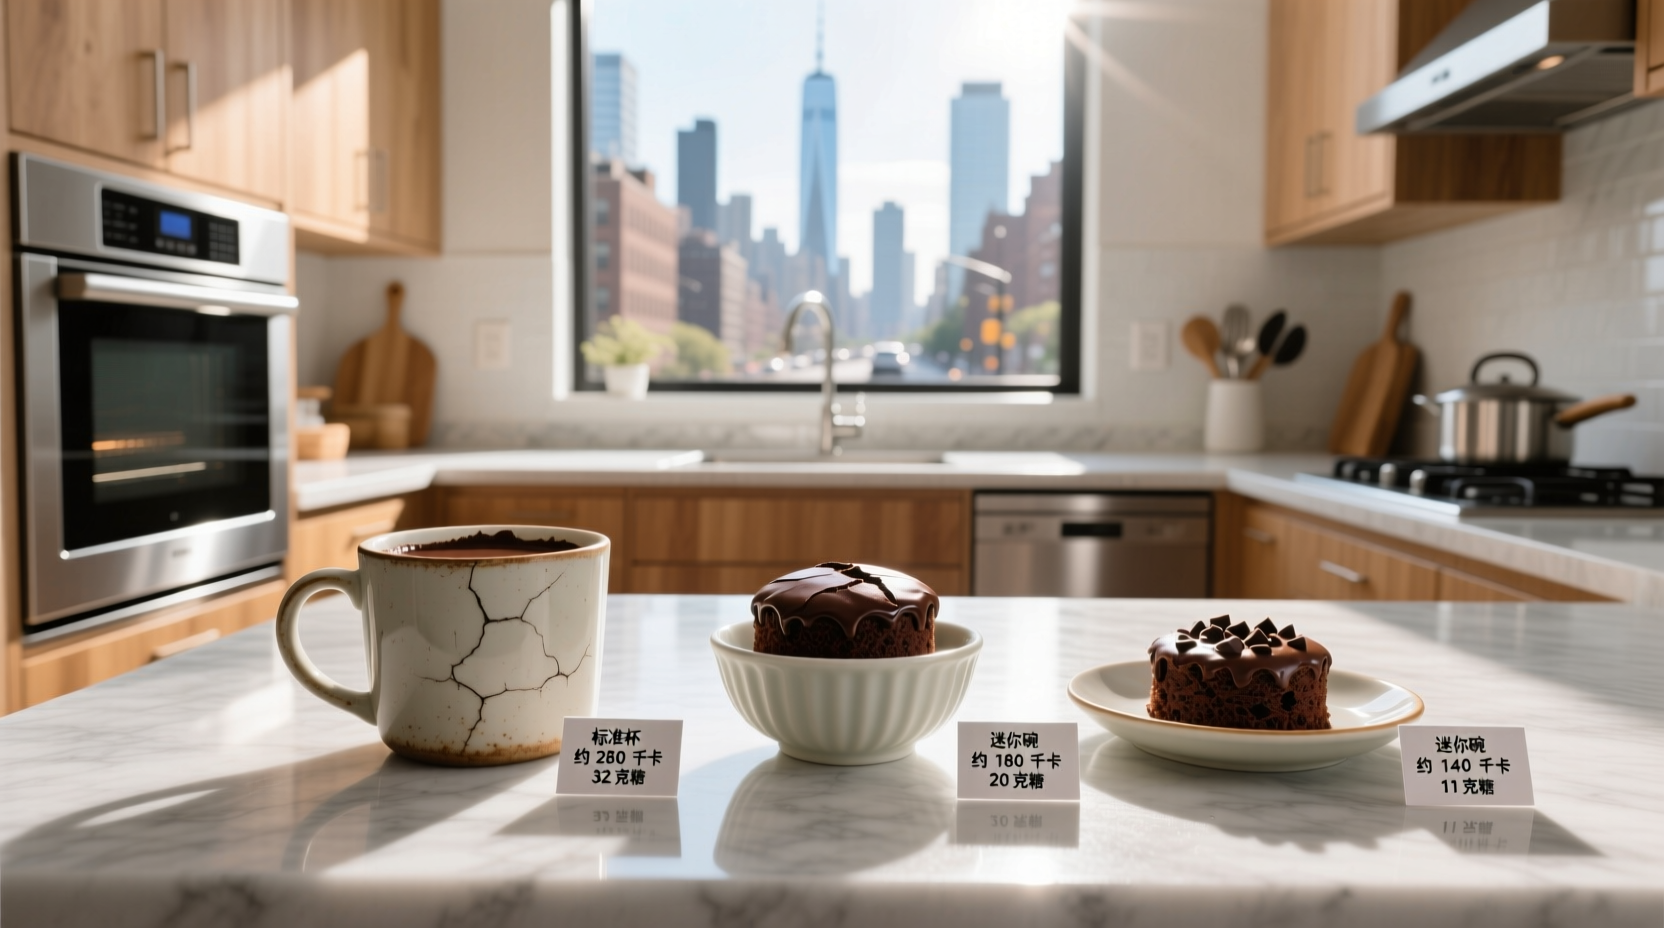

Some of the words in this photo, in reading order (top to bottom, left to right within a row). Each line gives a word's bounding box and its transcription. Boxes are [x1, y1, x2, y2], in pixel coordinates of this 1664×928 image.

[592, 727, 641, 746] 标准杯
[574, 748, 590, 765] 约
[633, 748, 663, 767] 千卡
[971, 752, 987, 769] 约
[996, 754, 1023, 768] 180
[1031, 752, 1061, 770] 千卡
[1417, 757, 1432, 774] 约
[1441, 758, 1471, 773] 140
[1479, 757, 1511, 775] 千卡
